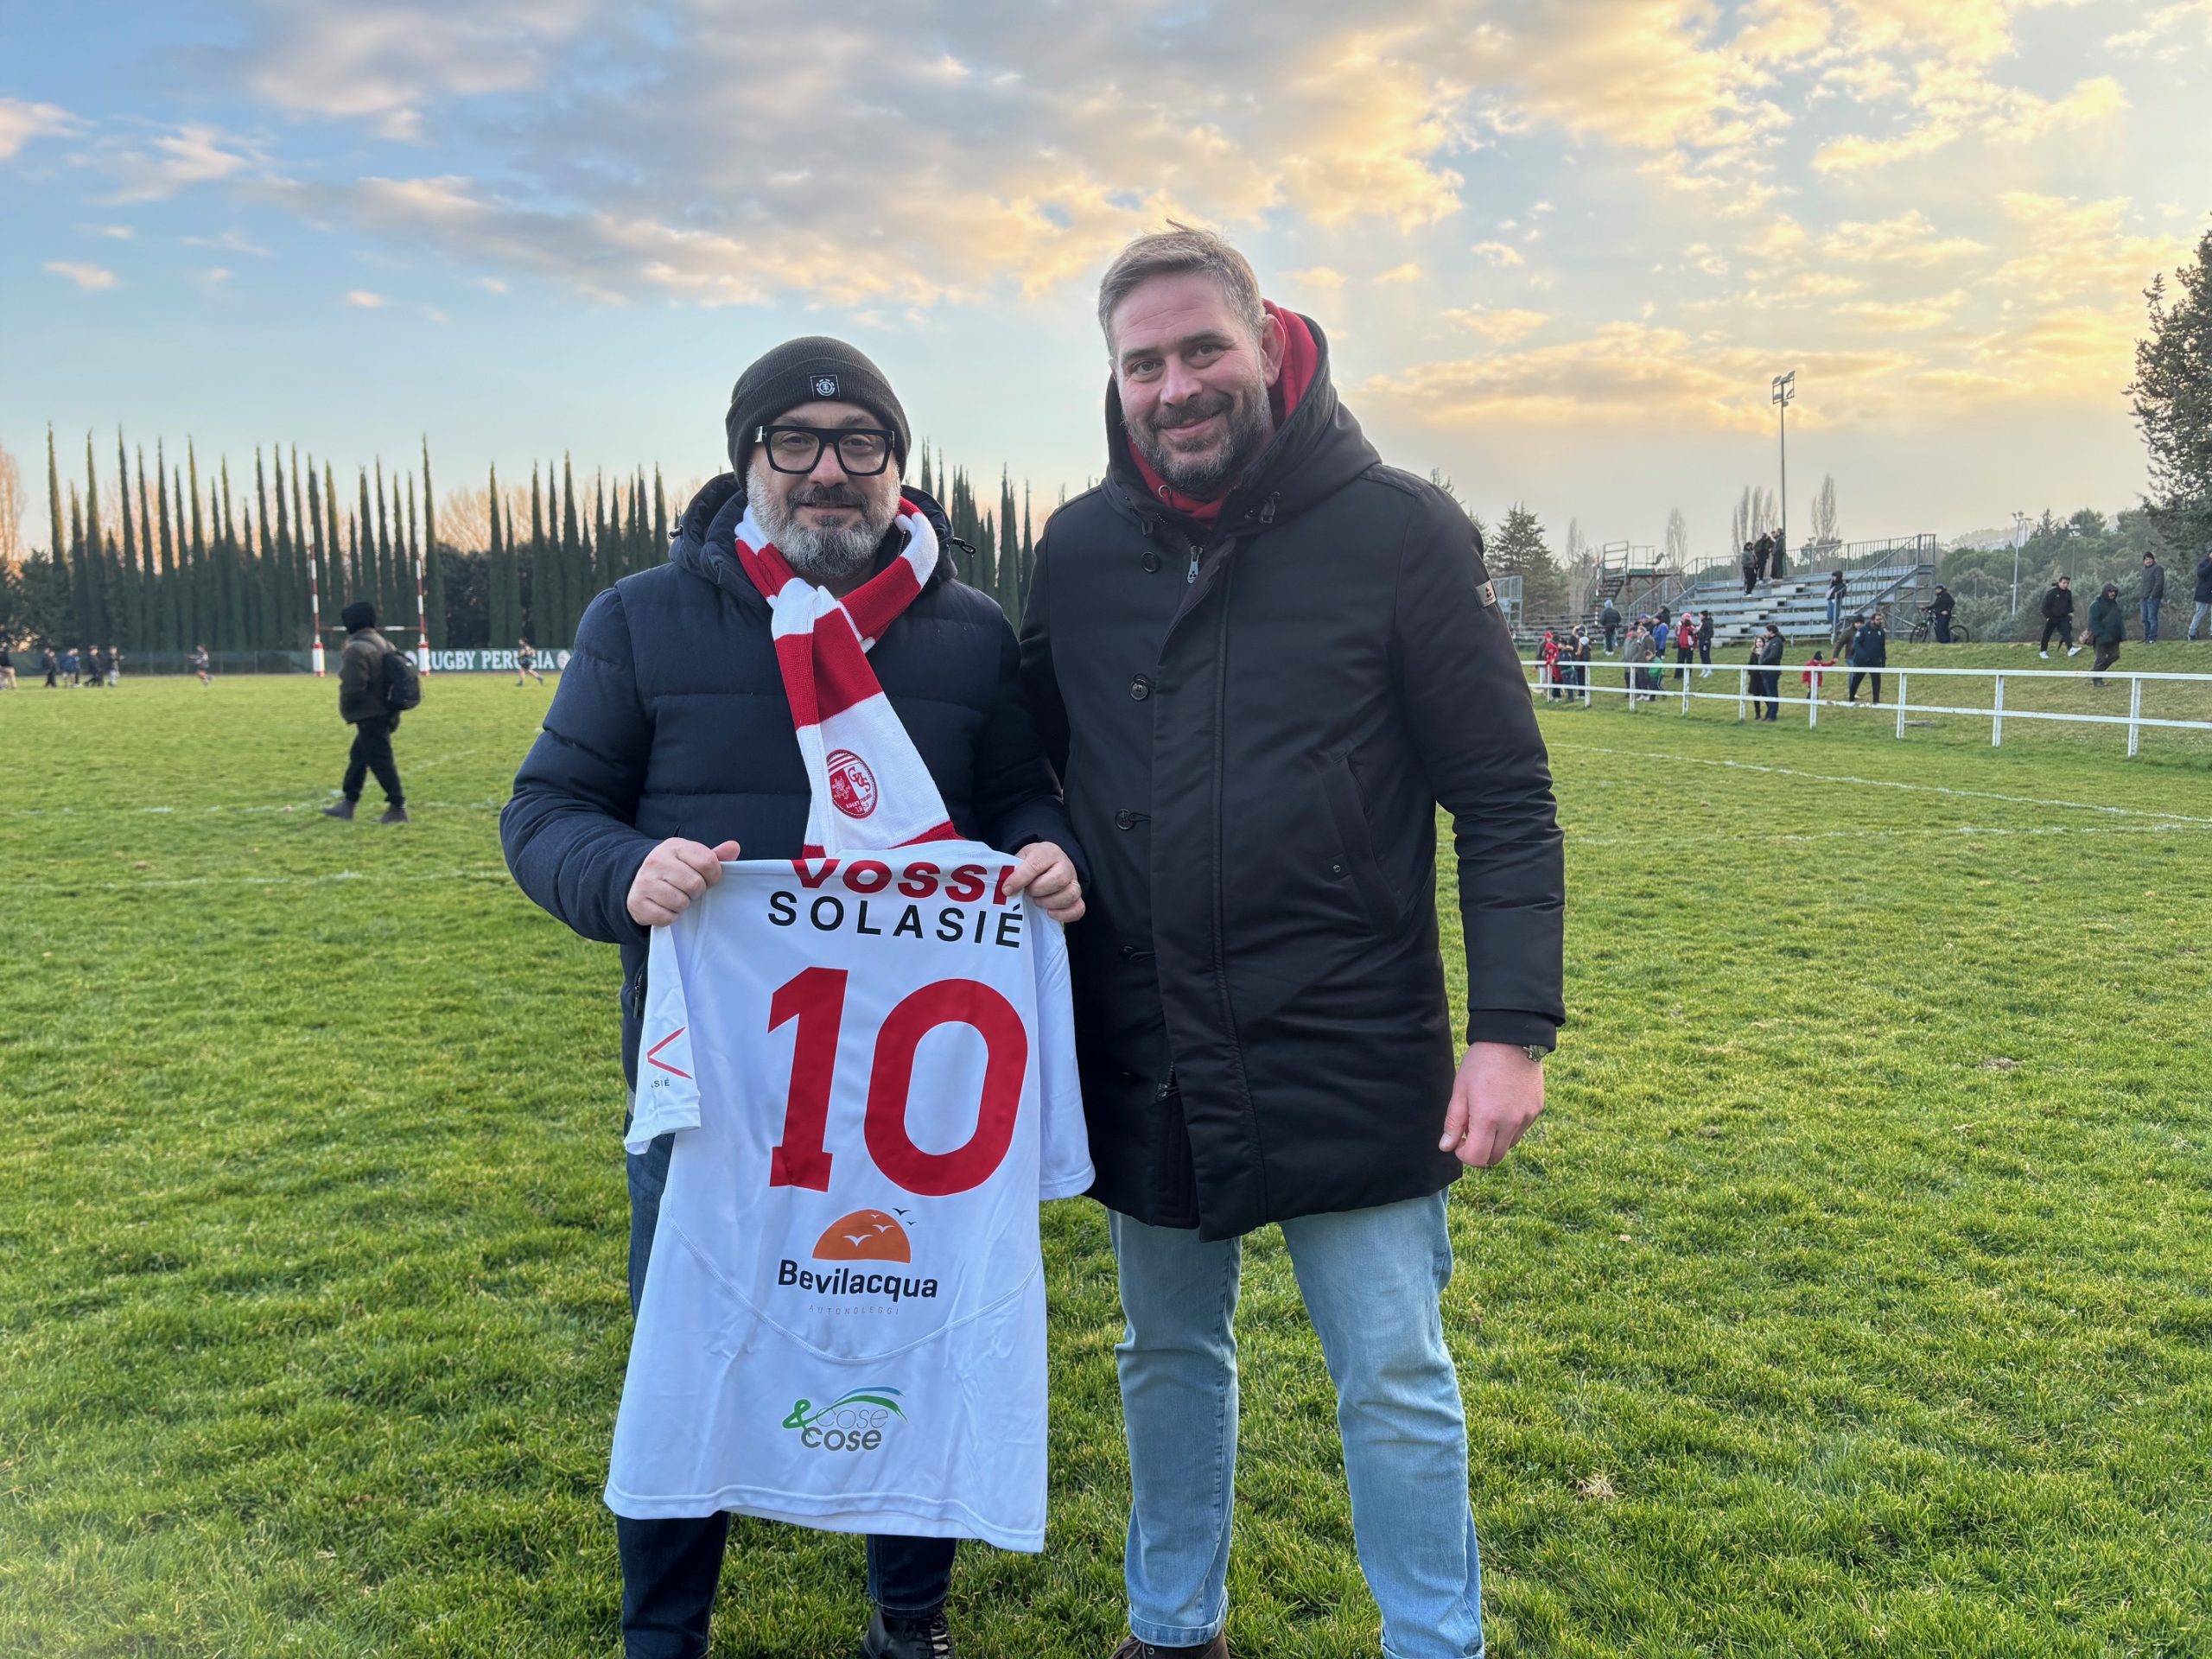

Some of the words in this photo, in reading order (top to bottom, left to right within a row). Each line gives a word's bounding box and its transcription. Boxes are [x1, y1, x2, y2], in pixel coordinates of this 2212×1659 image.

[429, 650, 474, 671] UGBY
[791, 858, 1015, 906] VOSSI
[767, 890, 1023, 949] SOLASIÉ
[651, 1077, 671, 1089] SIÉ
[767, 966, 1028, 1197] 10
[779, 1259, 938, 1303] Bevilacqua
[809, 1304, 899, 1315] AUTONOLEGGI
[816, 1407, 888, 1429] cose
[800, 1426, 882, 1452] cose
